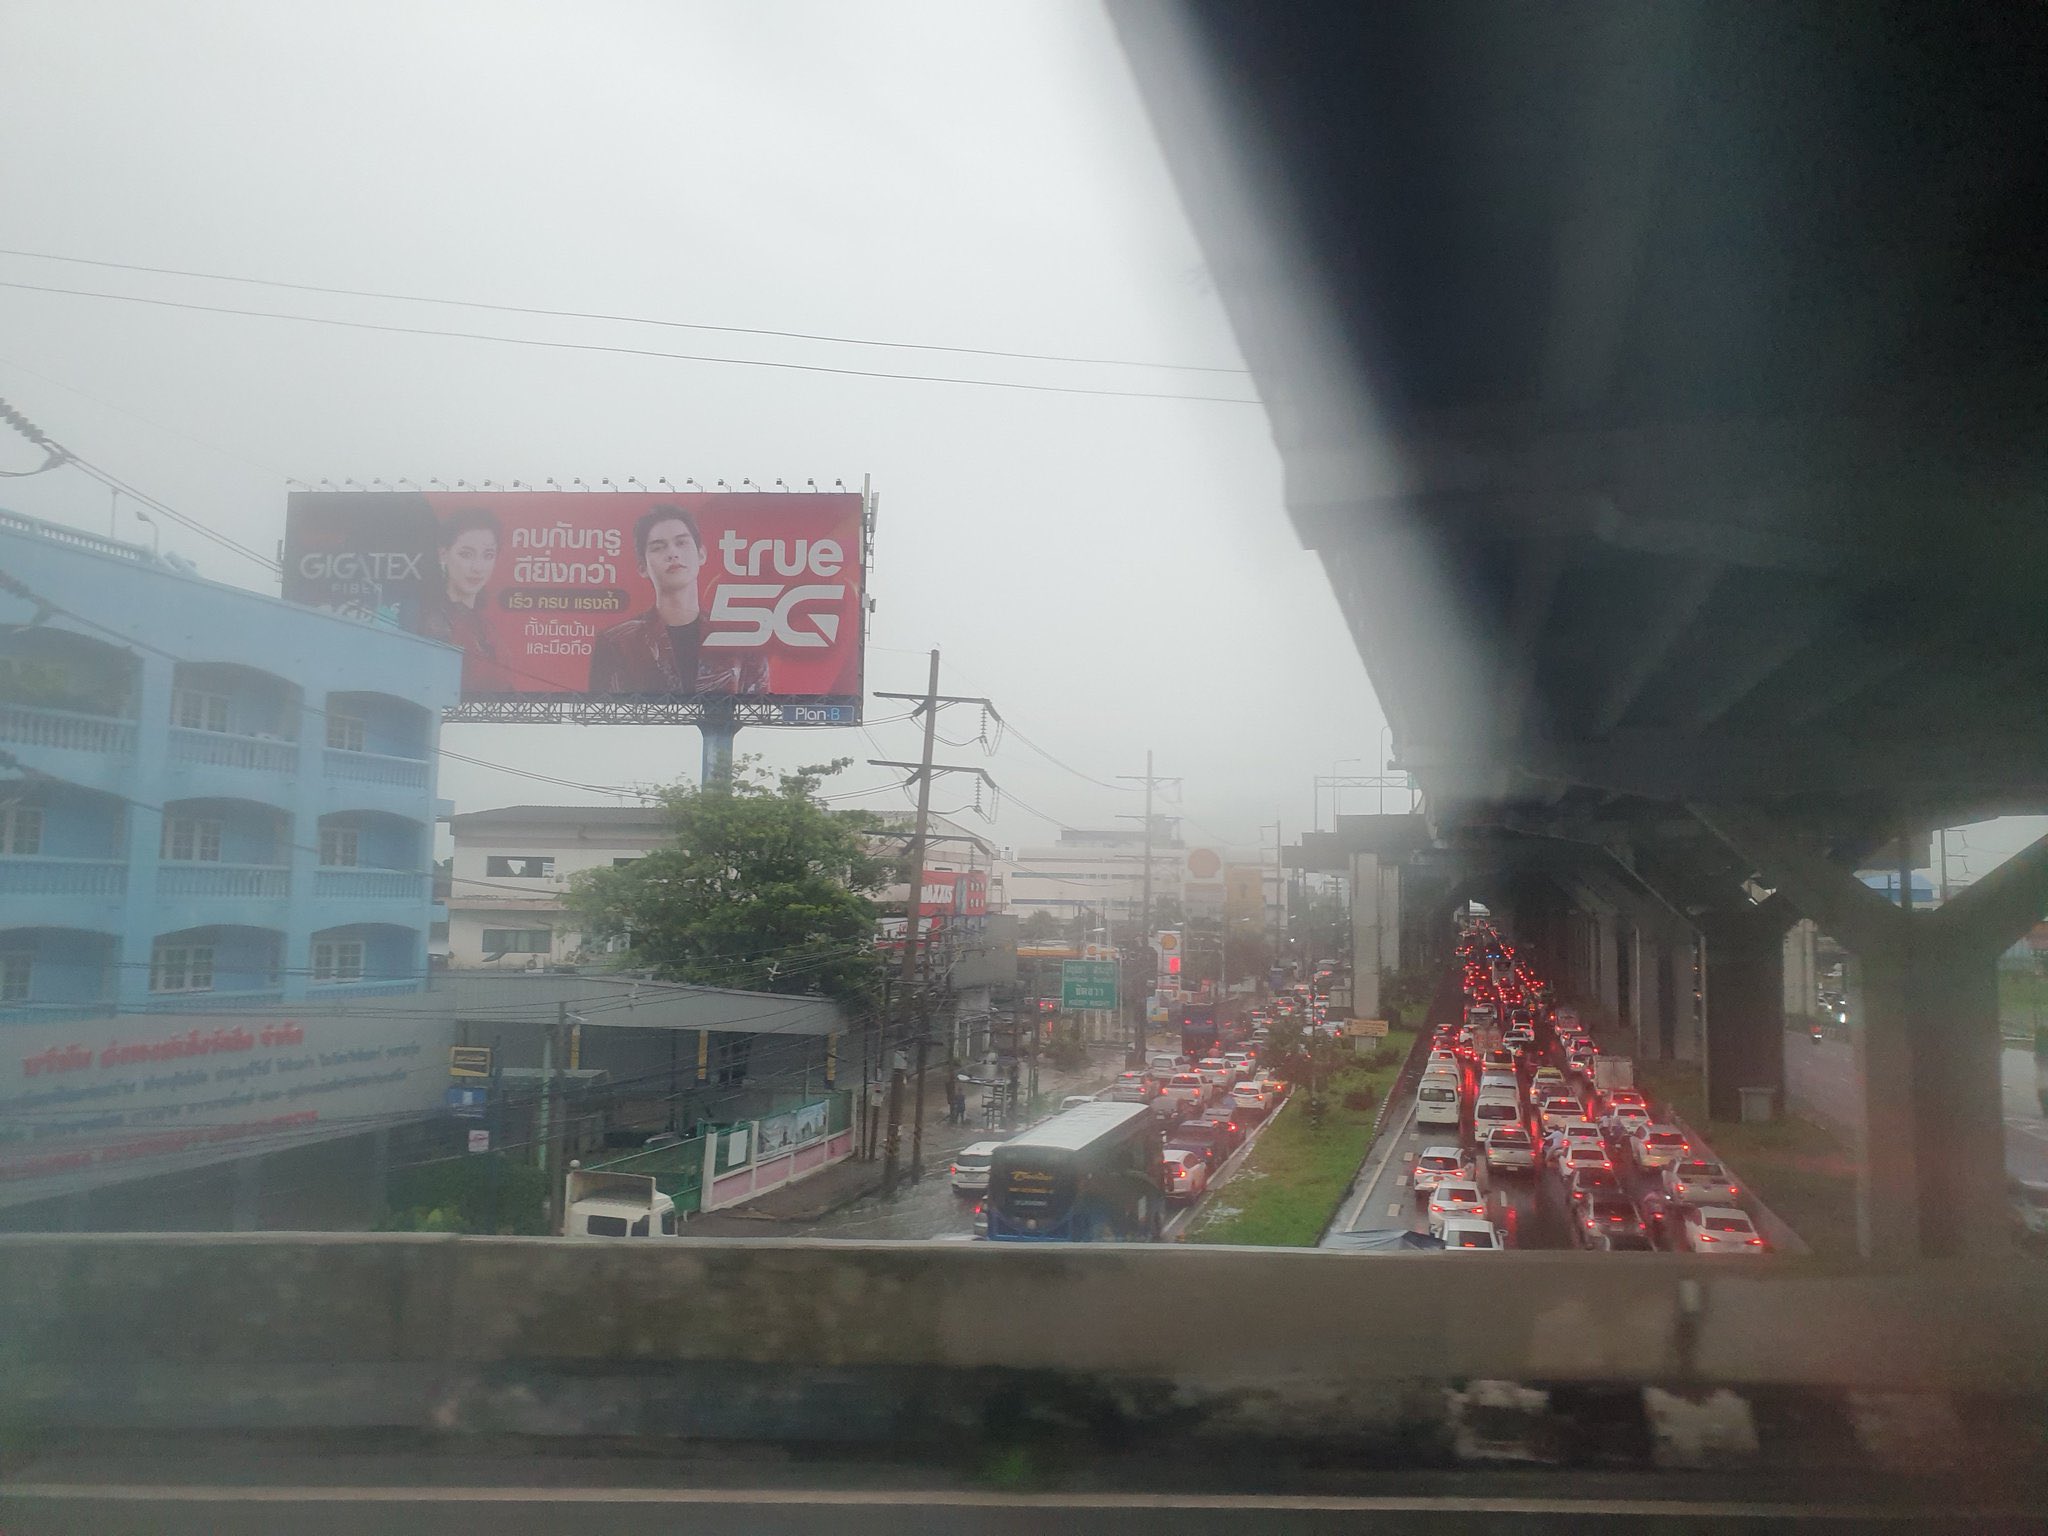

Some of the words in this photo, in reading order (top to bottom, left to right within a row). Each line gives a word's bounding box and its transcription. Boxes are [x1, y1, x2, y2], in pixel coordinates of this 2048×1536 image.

[512, 521, 621, 556] คบกับทรู
[718, 530, 844, 577] true
[299, 552, 424, 581] GIGATEX
[513, 549, 617, 584] ดียิ่งกว่า
[508, 592, 533, 609] เร็ว
[538, 596, 568, 609] ครบ
[702, 584, 846, 648] 5G
[524, 617, 595, 637] ทั้งเน็ตบ้าน
[526, 640, 593, 656] และมือถือ
